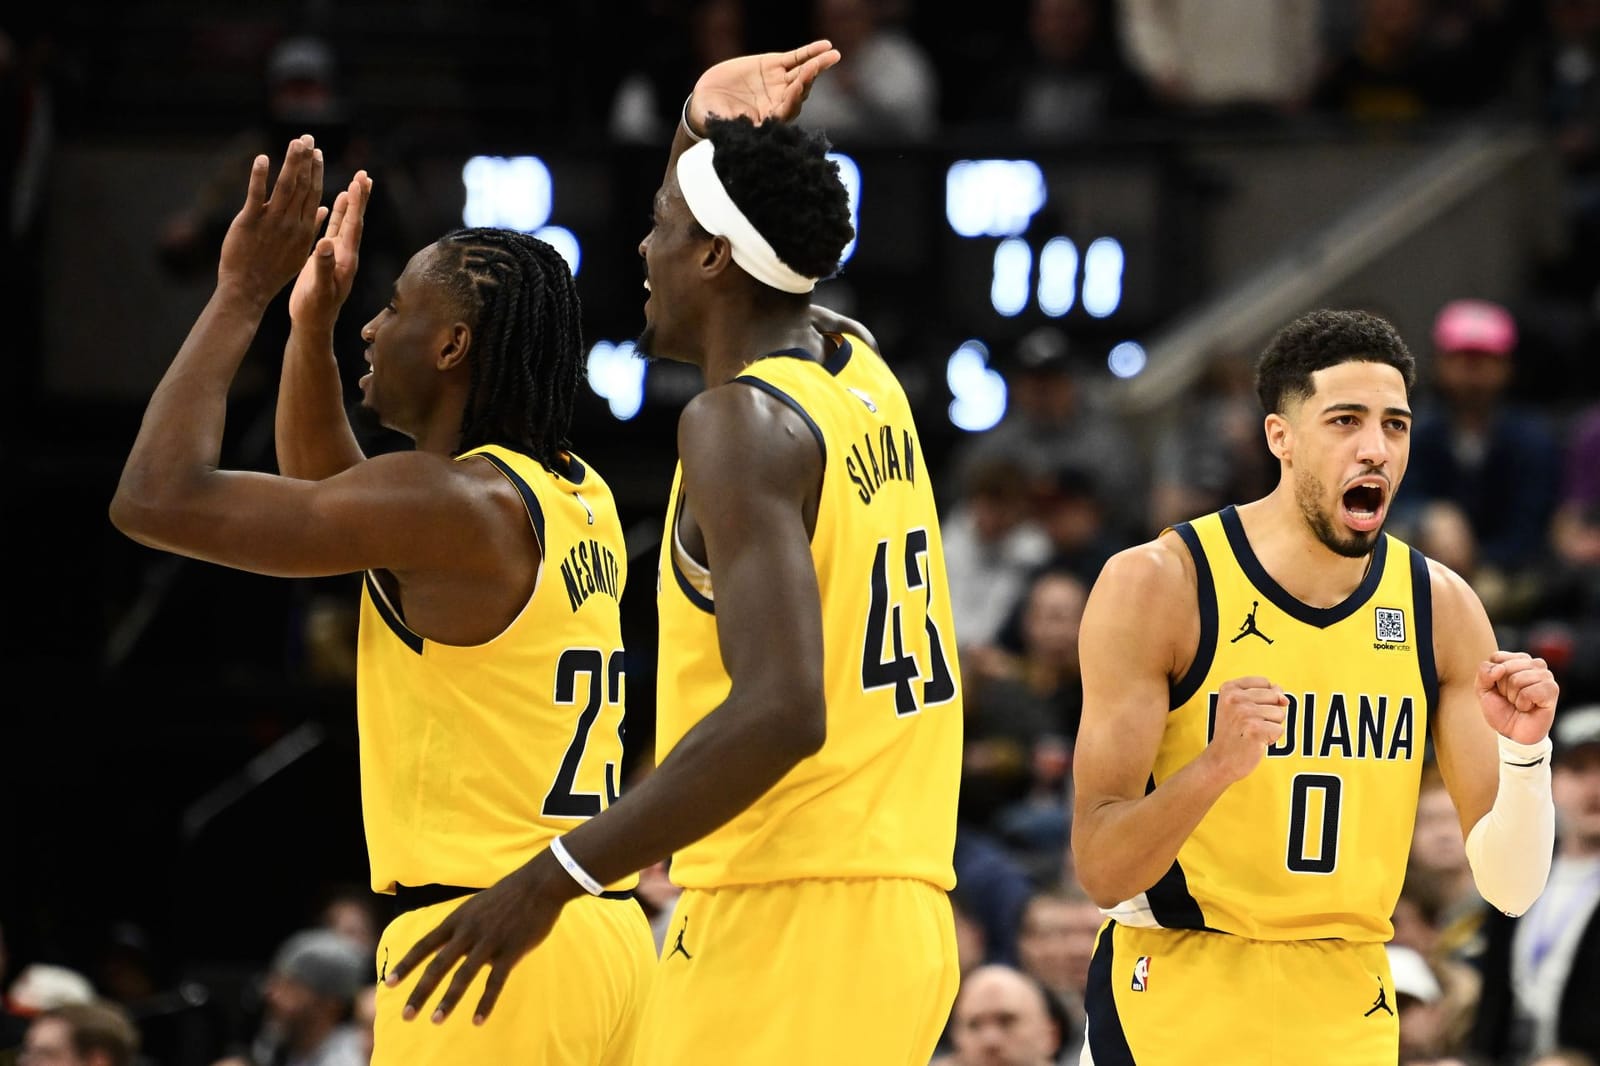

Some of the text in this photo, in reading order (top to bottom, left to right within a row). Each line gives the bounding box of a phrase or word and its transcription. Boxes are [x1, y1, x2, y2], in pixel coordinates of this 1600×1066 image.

[560, 539, 619, 613] NESMIT
[861, 529, 957, 718] 43
[1207, 692, 1414, 760] IDIANA
[1286, 772, 1343, 875] 0
